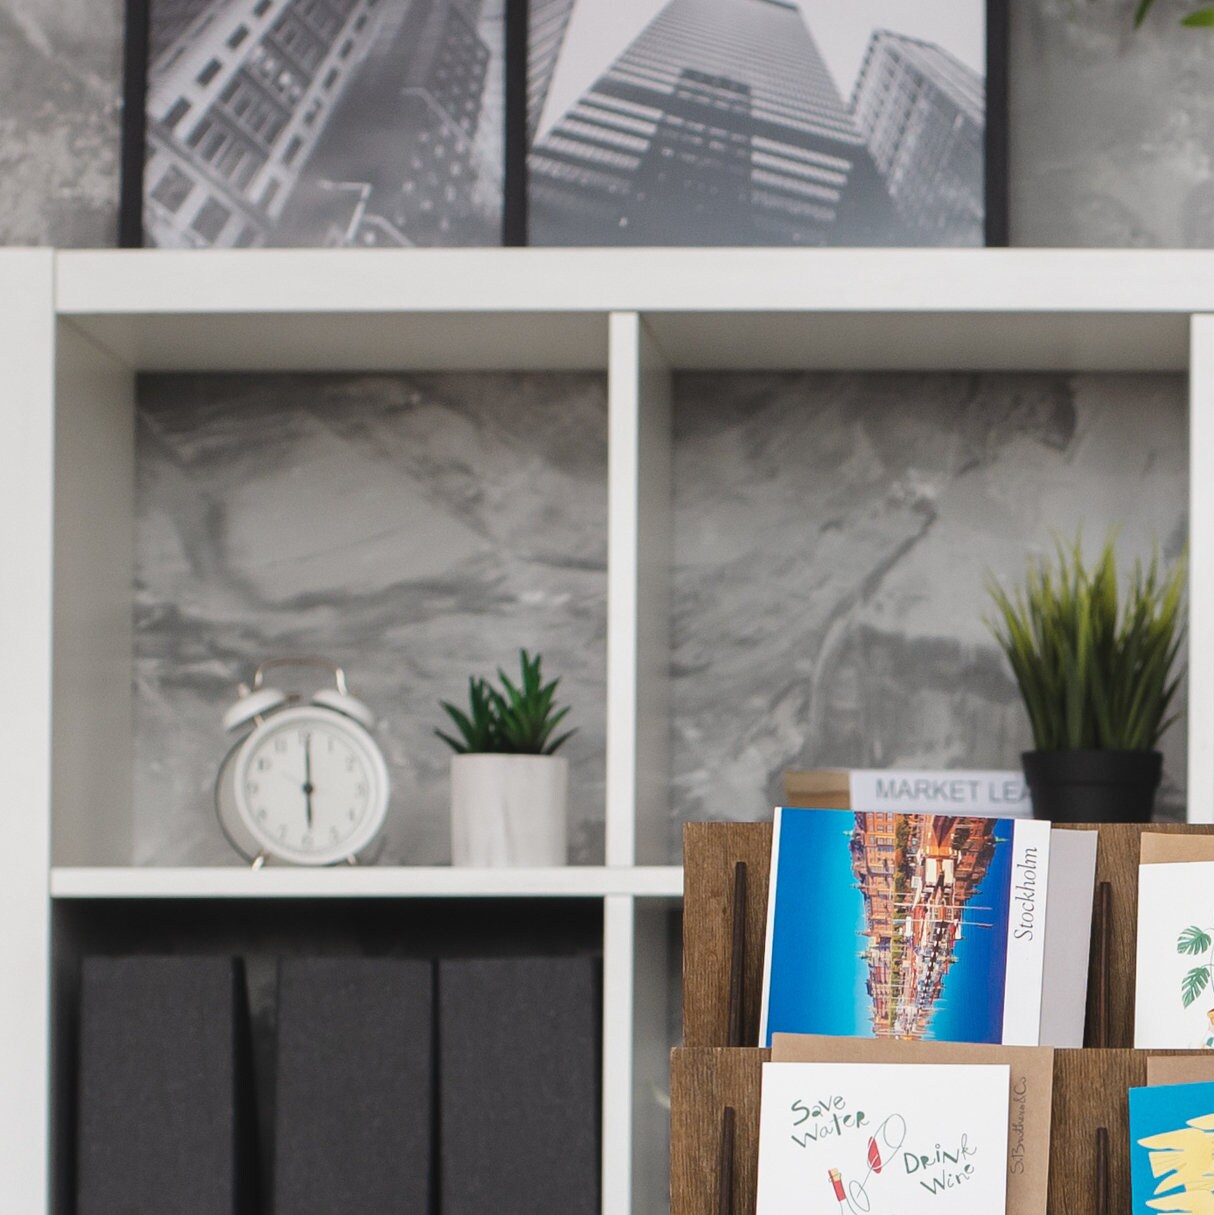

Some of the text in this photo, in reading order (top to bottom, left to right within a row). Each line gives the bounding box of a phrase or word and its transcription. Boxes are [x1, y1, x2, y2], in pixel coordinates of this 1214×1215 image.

[875, 777, 980, 802] MARKET
[1014, 846, 1039, 942] Stockholm
[791, 1095, 846, 1127] Save
[920, 1164, 975, 1195] Wine
